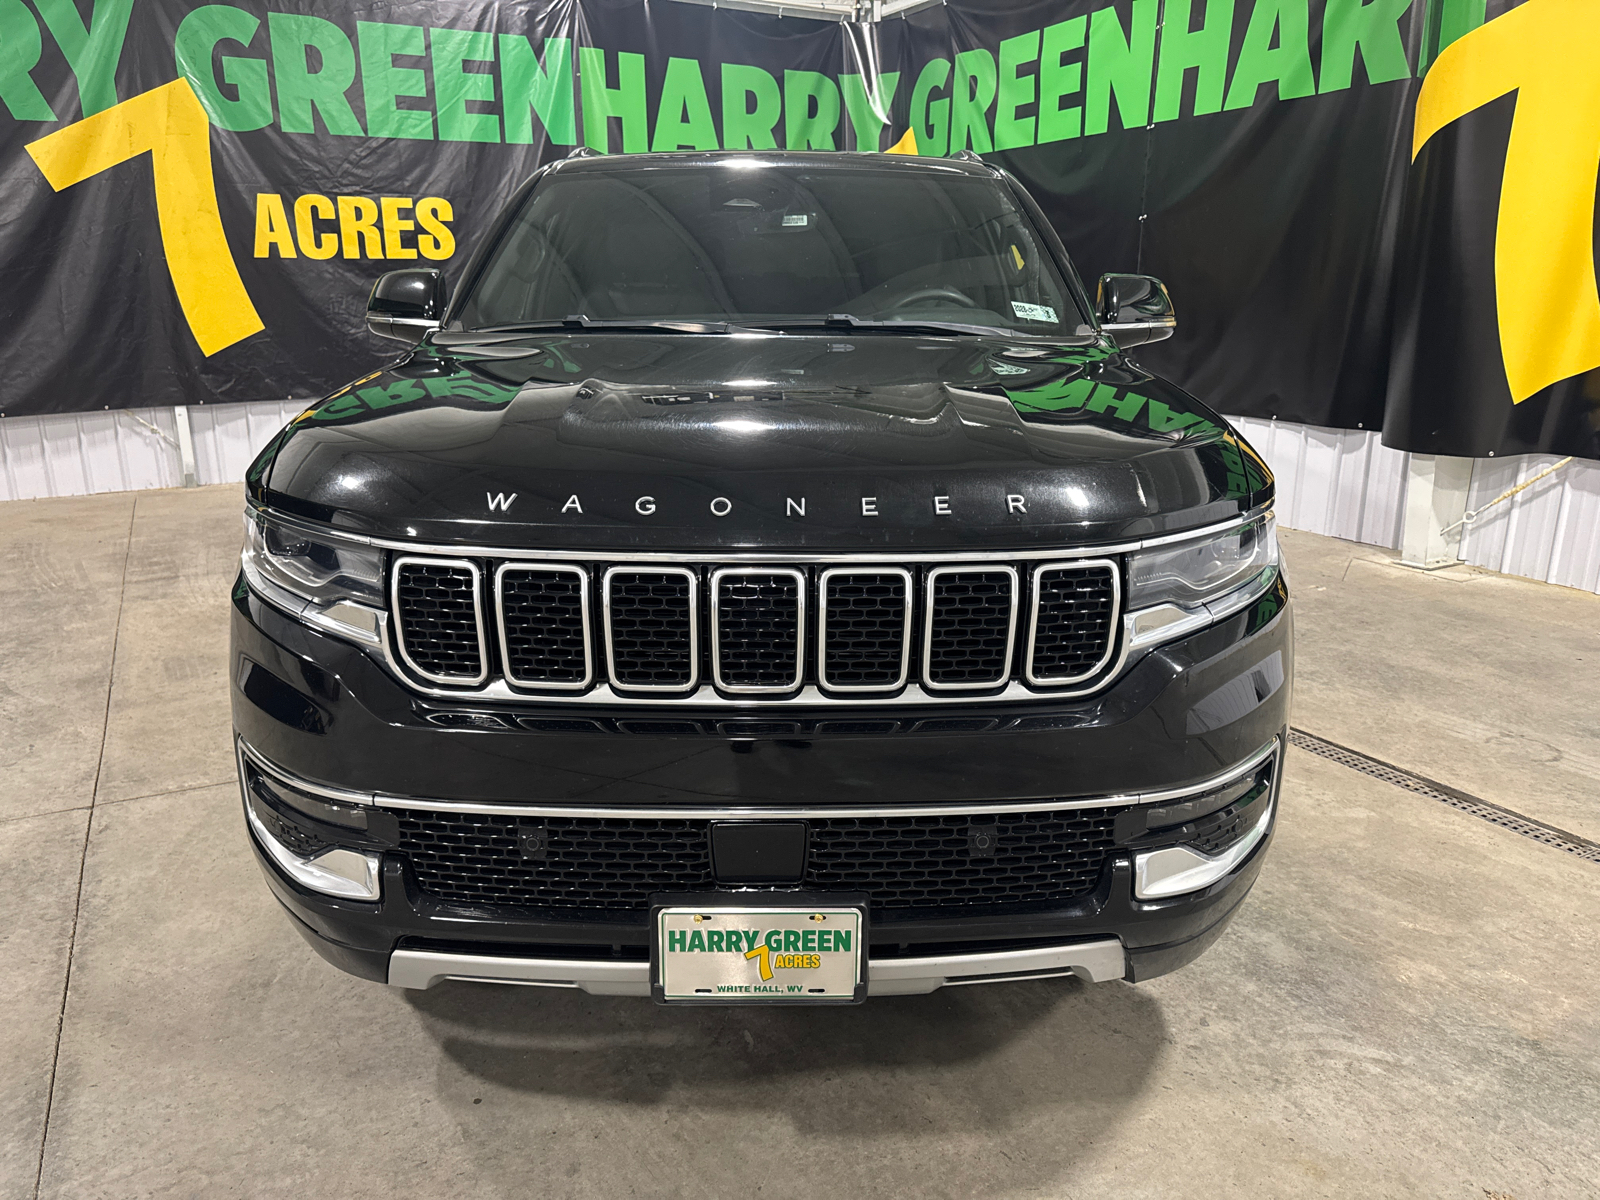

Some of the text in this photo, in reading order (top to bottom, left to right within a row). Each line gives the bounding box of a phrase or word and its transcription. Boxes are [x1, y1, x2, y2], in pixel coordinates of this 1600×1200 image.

[175, 4, 577, 146] GREEN
[579, 0, 1161, 155] HARRY GREEN
[24, 76, 456, 357] 7 ACRES
[486, 491, 1028, 517] WAGONEER
[668, 929, 852, 952] HARRY GREEN
[744, 945, 821, 982] 7 ACRES
[717, 985, 803, 994] WHITE HALL, WV
